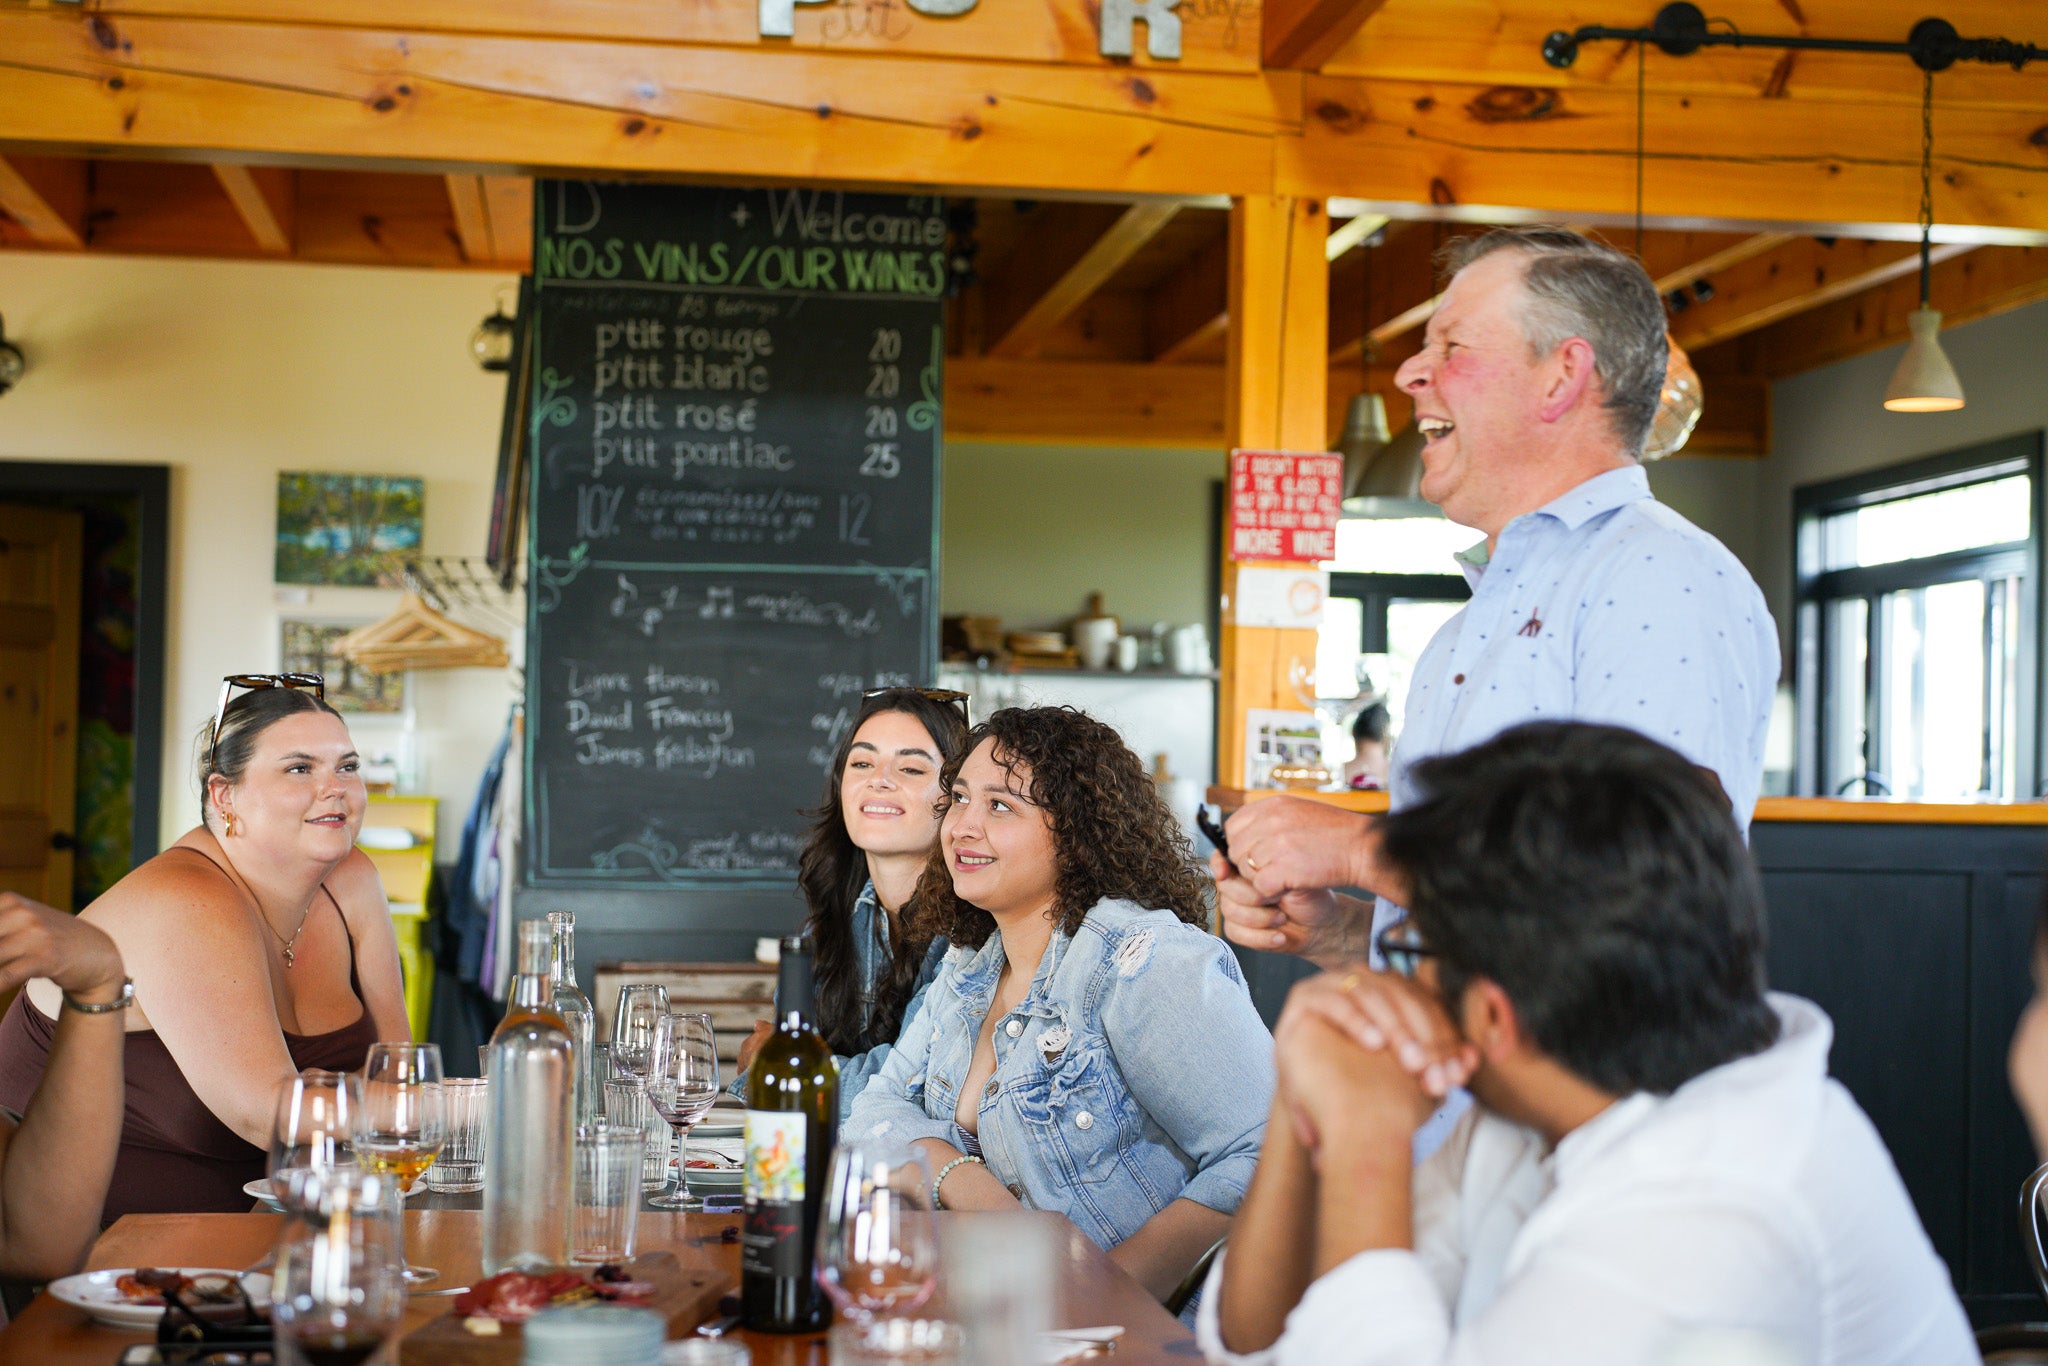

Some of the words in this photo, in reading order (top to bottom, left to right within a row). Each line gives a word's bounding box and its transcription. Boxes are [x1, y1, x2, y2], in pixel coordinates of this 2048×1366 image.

[766, 188, 946, 246] Welcome
[543, 237, 624, 279] NOS
[842, 247, 946, 296] WINES
[595, 318, 666, 358] p'tit
[674, 323, 773, 366] rouge
[869, 327, 901, 362] 20
[594, 353, 665, 398] p'tit
[671, 353, 769, 393] blanc
[865, 363, 900, 398] 20
[593, 393, 665, 438] p'tit
[675, 398, 757, 432] rosé
[865, 405, 898, 438] 20
[592, 435, 660, 479] p'tit
[671, 435, 796, 481] pontiac
[860, 442, 900, 478] 25
[1254, 476, 1275, 492] THE
[1281, 476, 1320, 496] GLASS
[837, 493, 872, 546] 12
[1234, 528, 1283, 555] MORE
[1293, 530, 1334, 557] WINE
[564, 699, 633, 732] David
